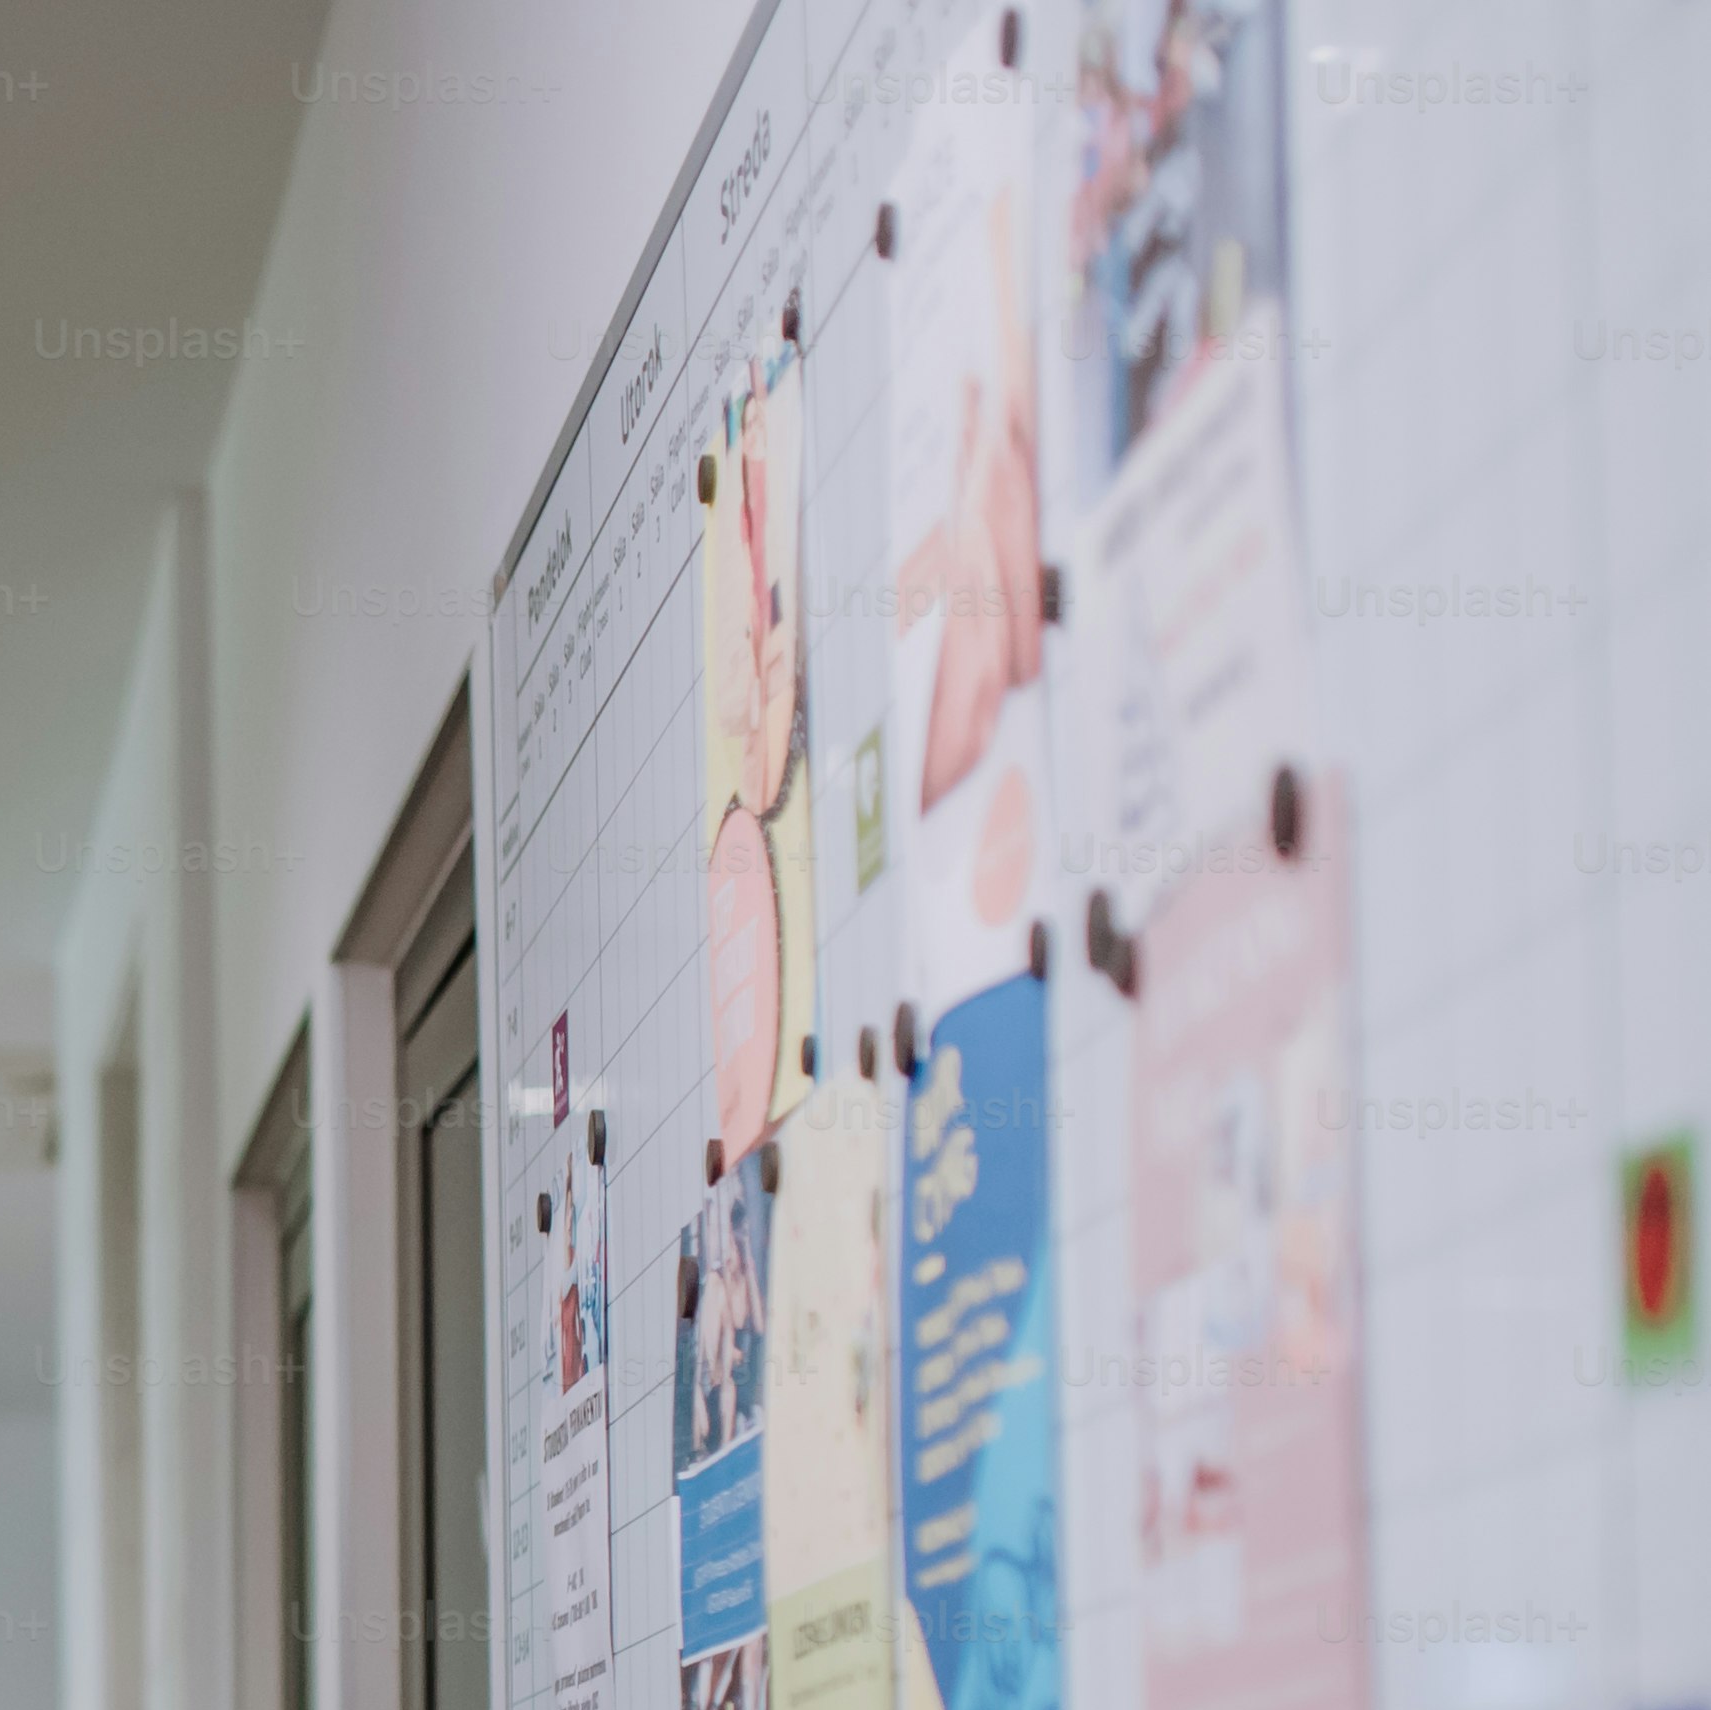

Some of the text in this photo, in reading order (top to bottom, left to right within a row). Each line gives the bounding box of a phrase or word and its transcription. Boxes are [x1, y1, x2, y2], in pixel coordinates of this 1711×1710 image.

[720, 108, 771, 246] Streda
[620, 322, 663, 446] Utorok
[528, 508, 572, 639] Pondelok
